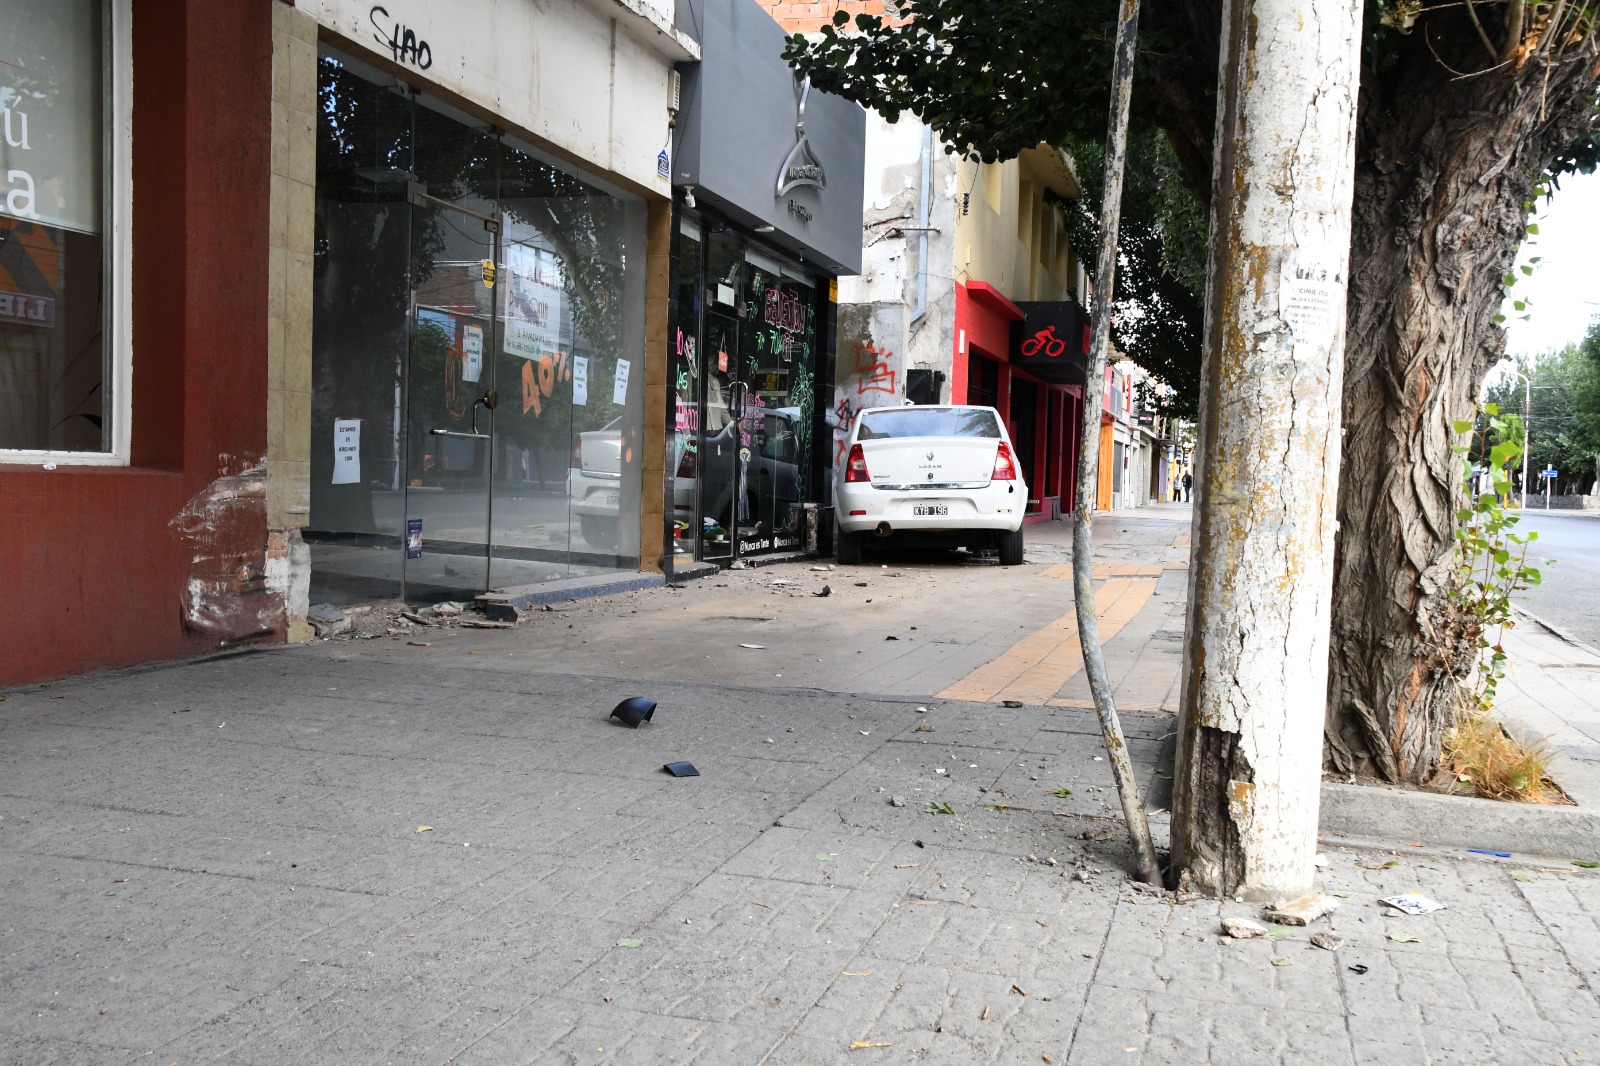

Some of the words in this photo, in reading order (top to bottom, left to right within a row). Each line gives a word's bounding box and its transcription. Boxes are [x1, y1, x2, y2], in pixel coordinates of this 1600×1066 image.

[0, 169, 41, 221] a
[521, 351, 571, 418] 40%
[933, 506, 948, 516] 196
